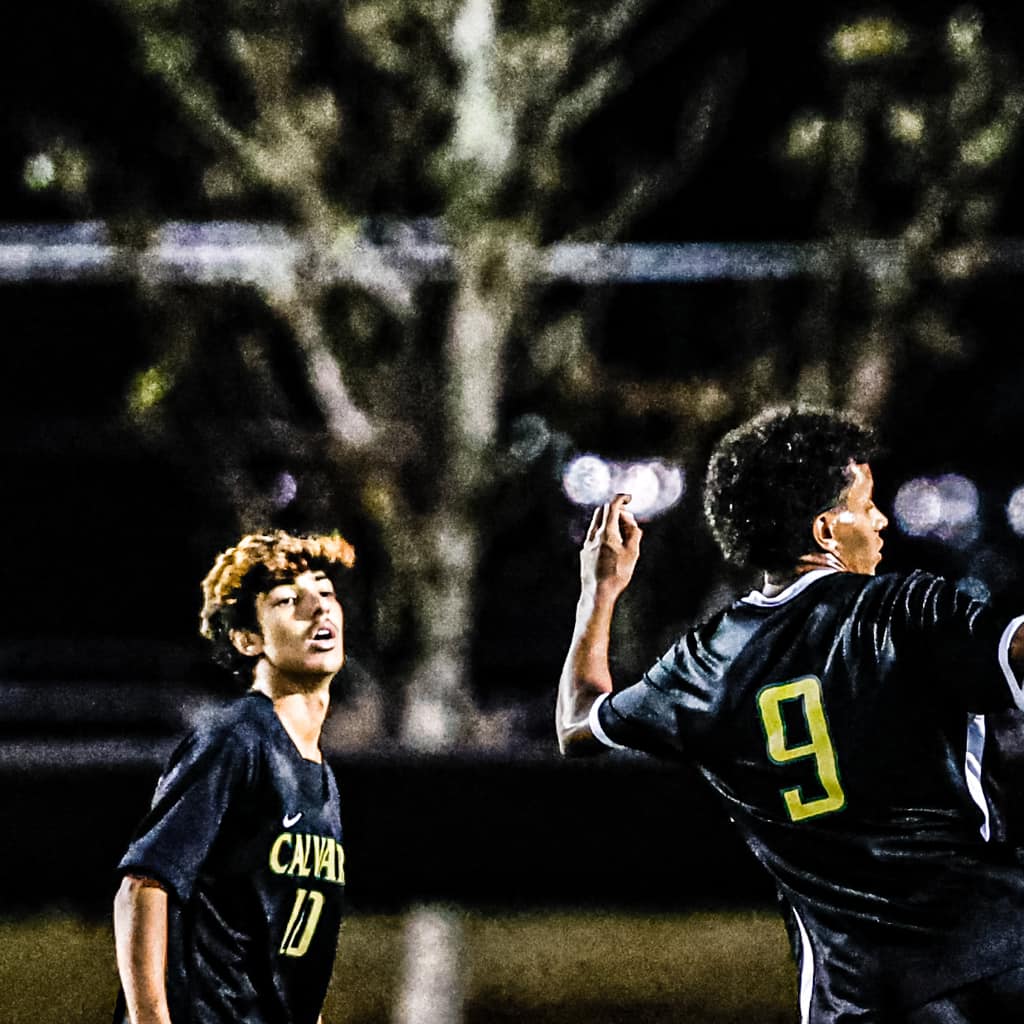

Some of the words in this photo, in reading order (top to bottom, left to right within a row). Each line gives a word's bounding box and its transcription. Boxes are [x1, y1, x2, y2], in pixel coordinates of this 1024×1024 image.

[756, 675, 846, 823] 9
[268, 831, 346, 887] CALVAR
[278, 887, 326, 957] 10
